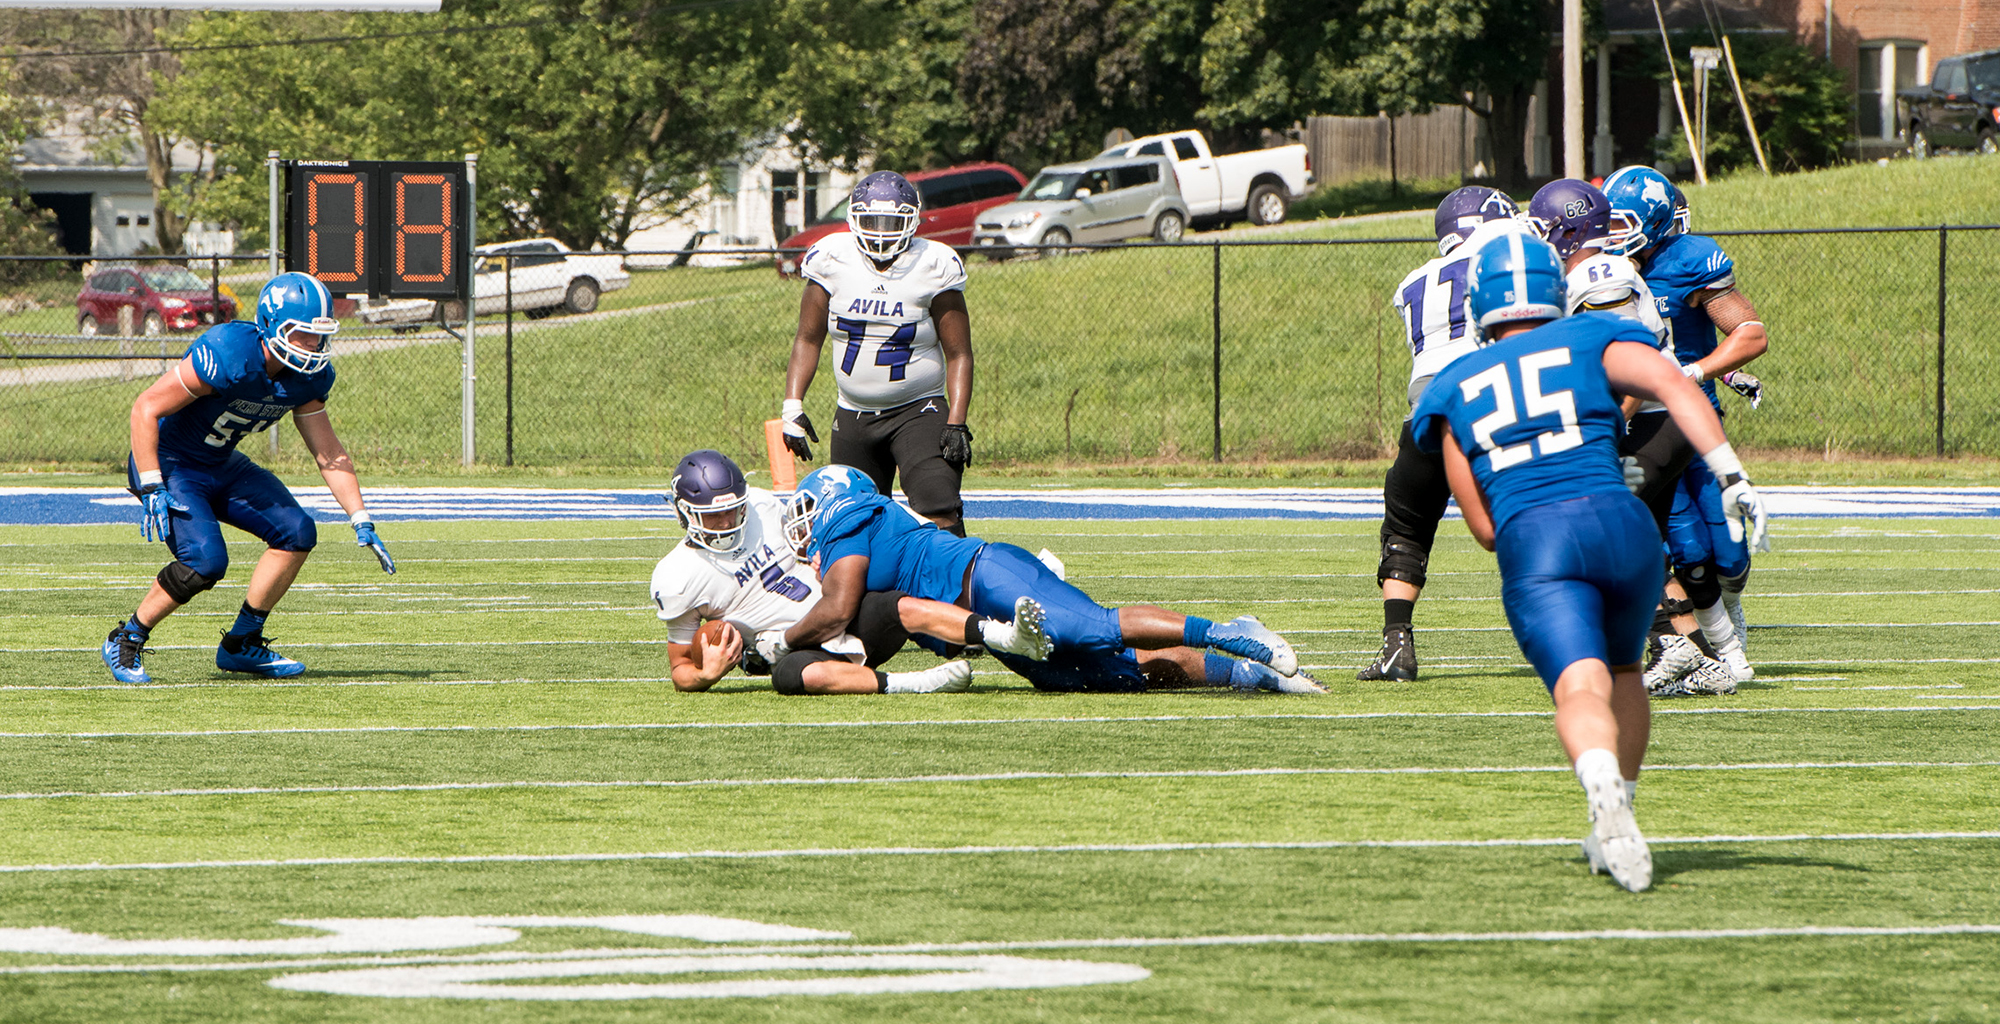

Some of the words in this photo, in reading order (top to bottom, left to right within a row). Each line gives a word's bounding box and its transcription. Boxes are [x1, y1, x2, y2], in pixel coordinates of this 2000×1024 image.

[308, 174, 451, 282] 08
[1565, 200, 1588, 219] 62
[1588, 263, 1613, 283] 62
[848, 298, 904, 317] AVILA
[836, 316, 918, 382] 74
[1458, 346, 1584, 473] 25
[735, 544, 776, 588] AVILA
